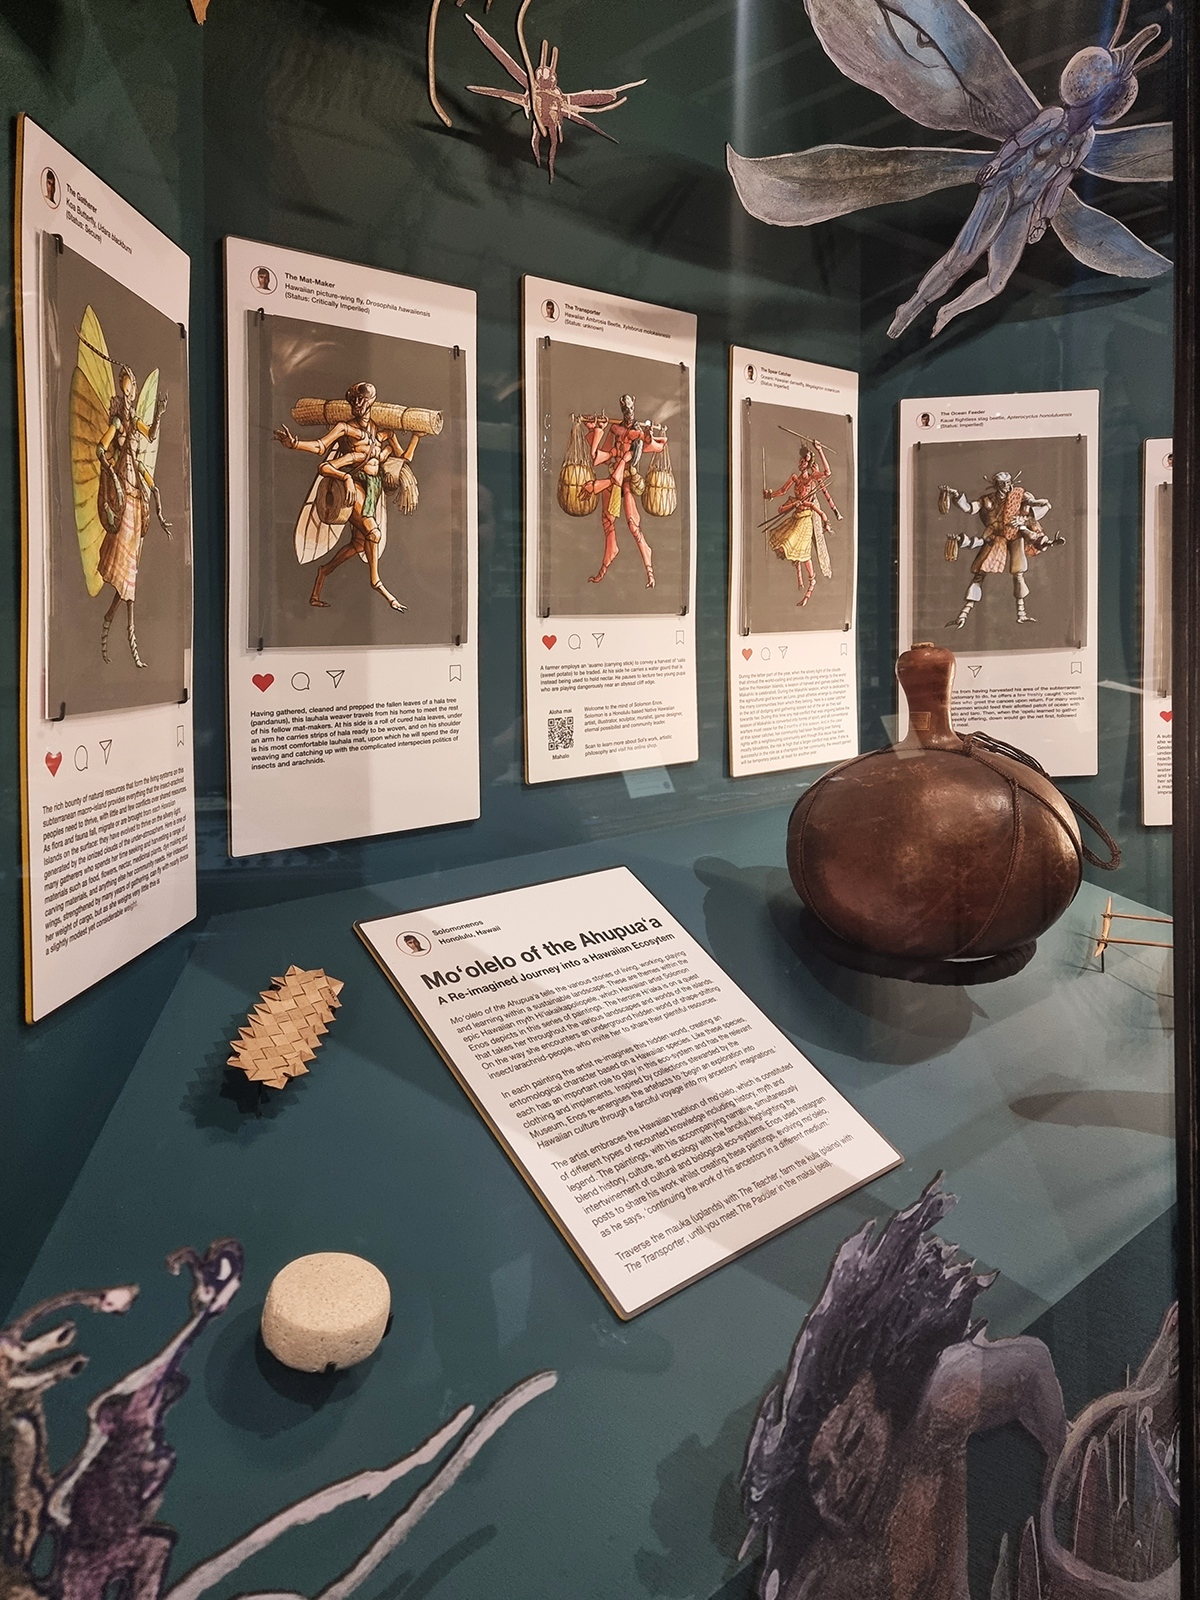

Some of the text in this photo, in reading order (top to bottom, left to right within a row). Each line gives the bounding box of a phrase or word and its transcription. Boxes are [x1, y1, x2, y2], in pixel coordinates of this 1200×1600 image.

[284, 272, 335, 288] The Mat-Maker
[284, 291, 370, 315] (Status: Critically Imperiled)
[285, 283, 315, 294] Hawaiian
[316, 290, 355, 304] picture-wing
[356, 297, 364, 305] fly,
[366, 299, 397, 311] Drosophila
[574, 305, 601, 316] Transporter
[276, 708, 307, 717] gathered,
[308, 705, 334, 713] cleaned
[335, 704, 348, 712] and
[348, 703, 374, 712] prepped
[250, 717, 290, 727] (pandanus),
[251, 757, 325, 770] insects and arachnids.
[431, 920, 484, 936] Solomonenos
[438, 925, 502, 945] Honolulu, Hawaii
[520, 945, 542, 963] of
[542, 940, 577, 956] the
[438, 996, 448, 1006] A
[447, 975, 519, 1002] Re-imagined
[520, 965, 561, 982] Journey
[559, 960, 581, 970] into
[588, 945, 633, 962] Hawaiian
[630, 933, 676, 950] Ecosytem
[500, 1091, 512, 1099] In
[511, 1083, 532, 1095] each
[531, 1072, 563, 1090] painting
[561, 1068, 576, 1076] the
[575, 1060, 595, 1072] artist
[594, 1046, 635, 1065] re-imagines
[632, 1042, 648, 1050] this
[645, 1034, 670, 1046] hidden
[668, 1026, 690, 1037] world,
[688, 1018, 715, 1030] creating
[508, 1083, 563, 1109] entomological
[562, 1071, 597, 1088] character
[596, 1062, 620, 1075] based
[619, 1059, 631, 1067] on
[634, 1046, 666, 1061] Hawaiian
[665, 1037, 692, 1050] species.
[690, 1032, 706, 1040] Like
[704, 1025, 723, 1035] these
[722, 1017, 747, 1029] species,
[614, 1134, 854, 1261] Traverse the mauka (uplands) with The Teacher, farm the kula (plains) with
[624, 1159, 833, 1273] The Transporter, until you meet The Paddler in the makai (sea).
